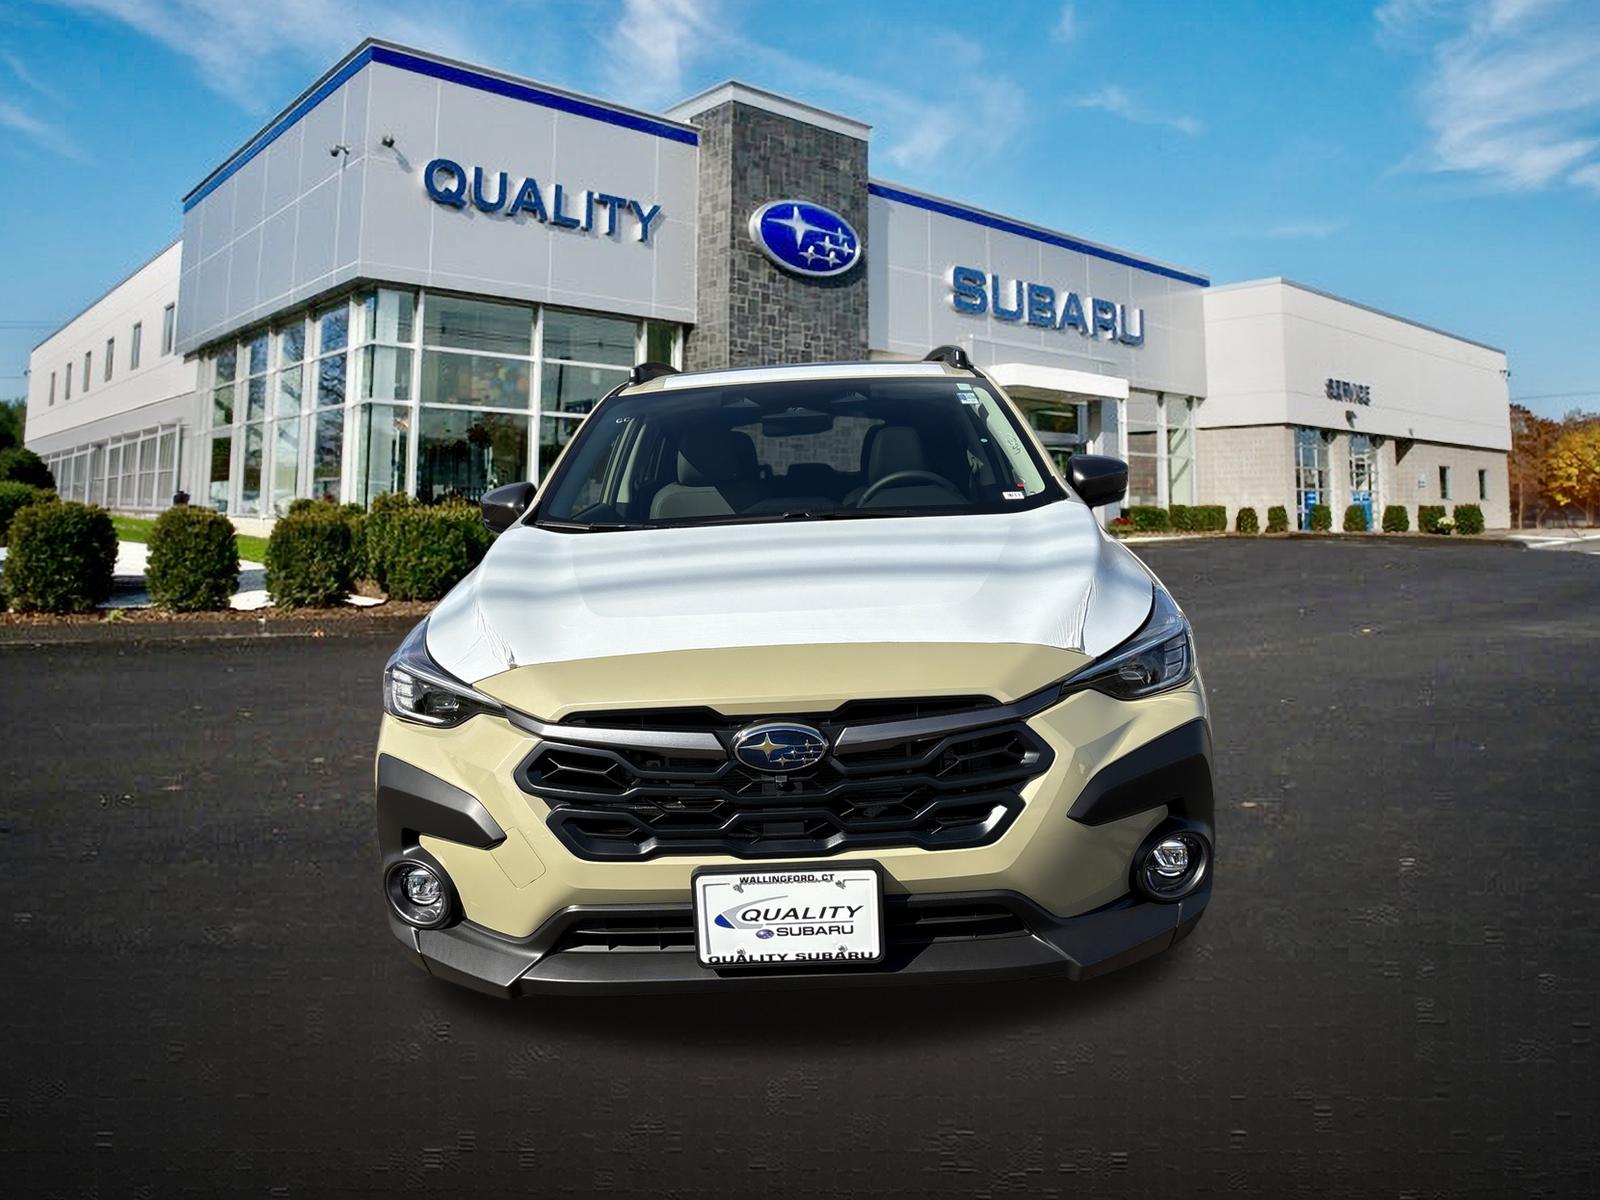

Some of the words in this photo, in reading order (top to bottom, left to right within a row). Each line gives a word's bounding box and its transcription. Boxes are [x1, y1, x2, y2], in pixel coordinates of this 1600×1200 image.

[423, 158, 661, 243] QUALITY
[951, 265, 1145, 347] SUBARU
[822, 873, 835, 882] CT
[741, 905, 864, 922] QUALITY
[776, 925, 854, 937] SUBARU
[708, 953, 788, 964] QUALITY
[795, 951, 873, 961] SUBARU
